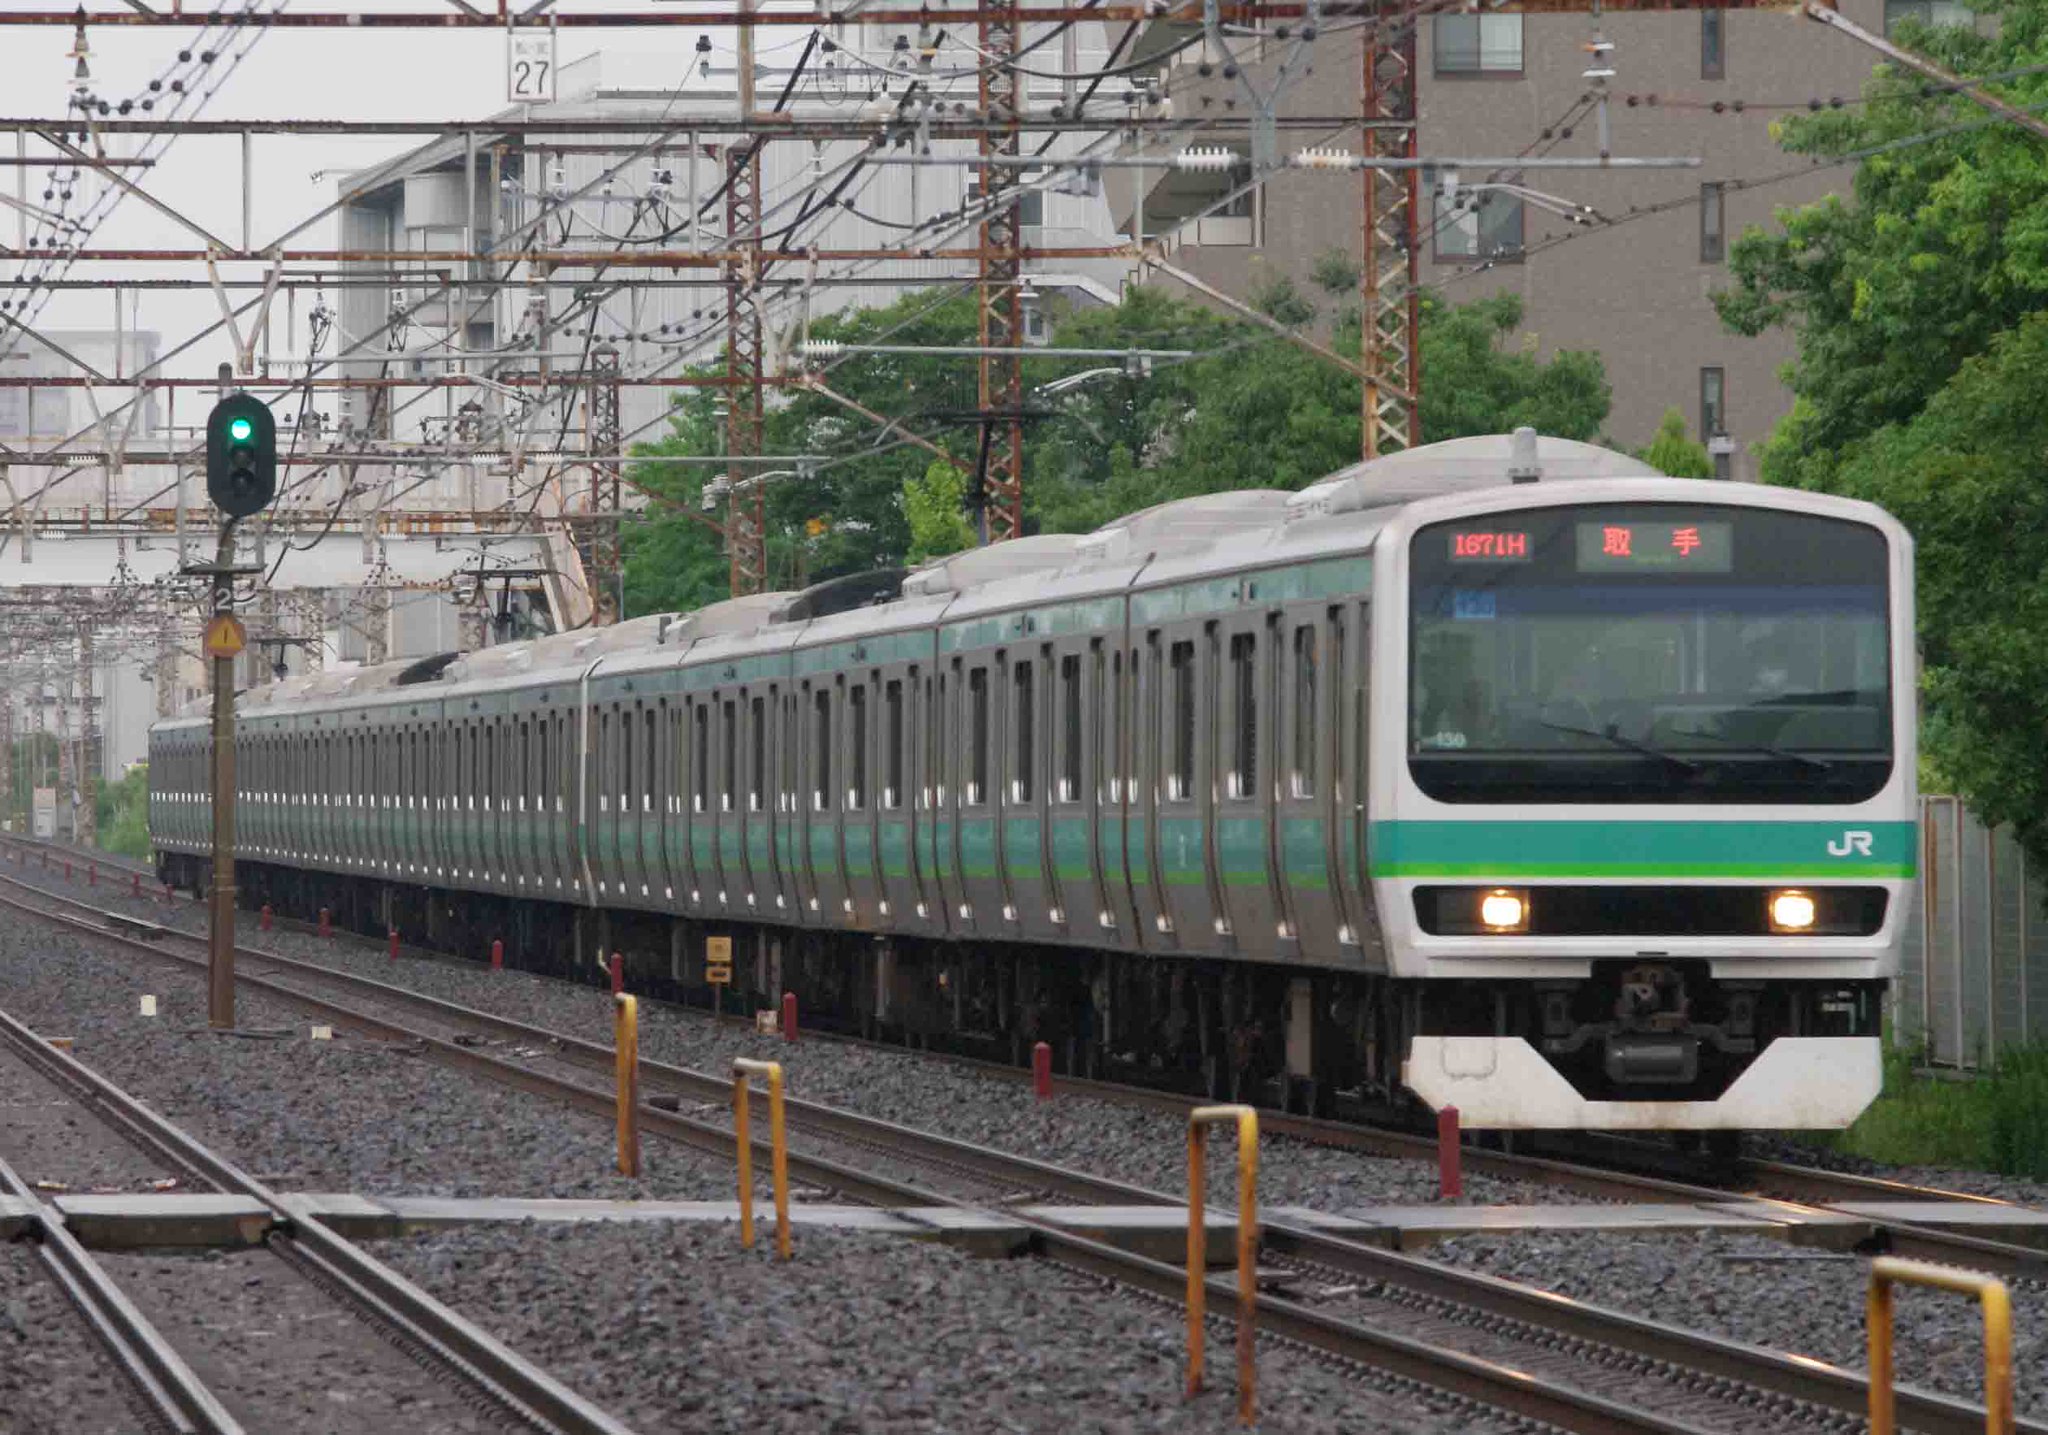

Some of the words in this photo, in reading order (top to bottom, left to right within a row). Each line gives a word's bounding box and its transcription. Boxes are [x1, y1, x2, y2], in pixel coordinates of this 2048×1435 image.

[515, 61, 549, 94] 27
[1455, 532, 1526, 556] 1671H
[216, 588, 232, 609] 2
[1827, 830, 1873, 856] JR
